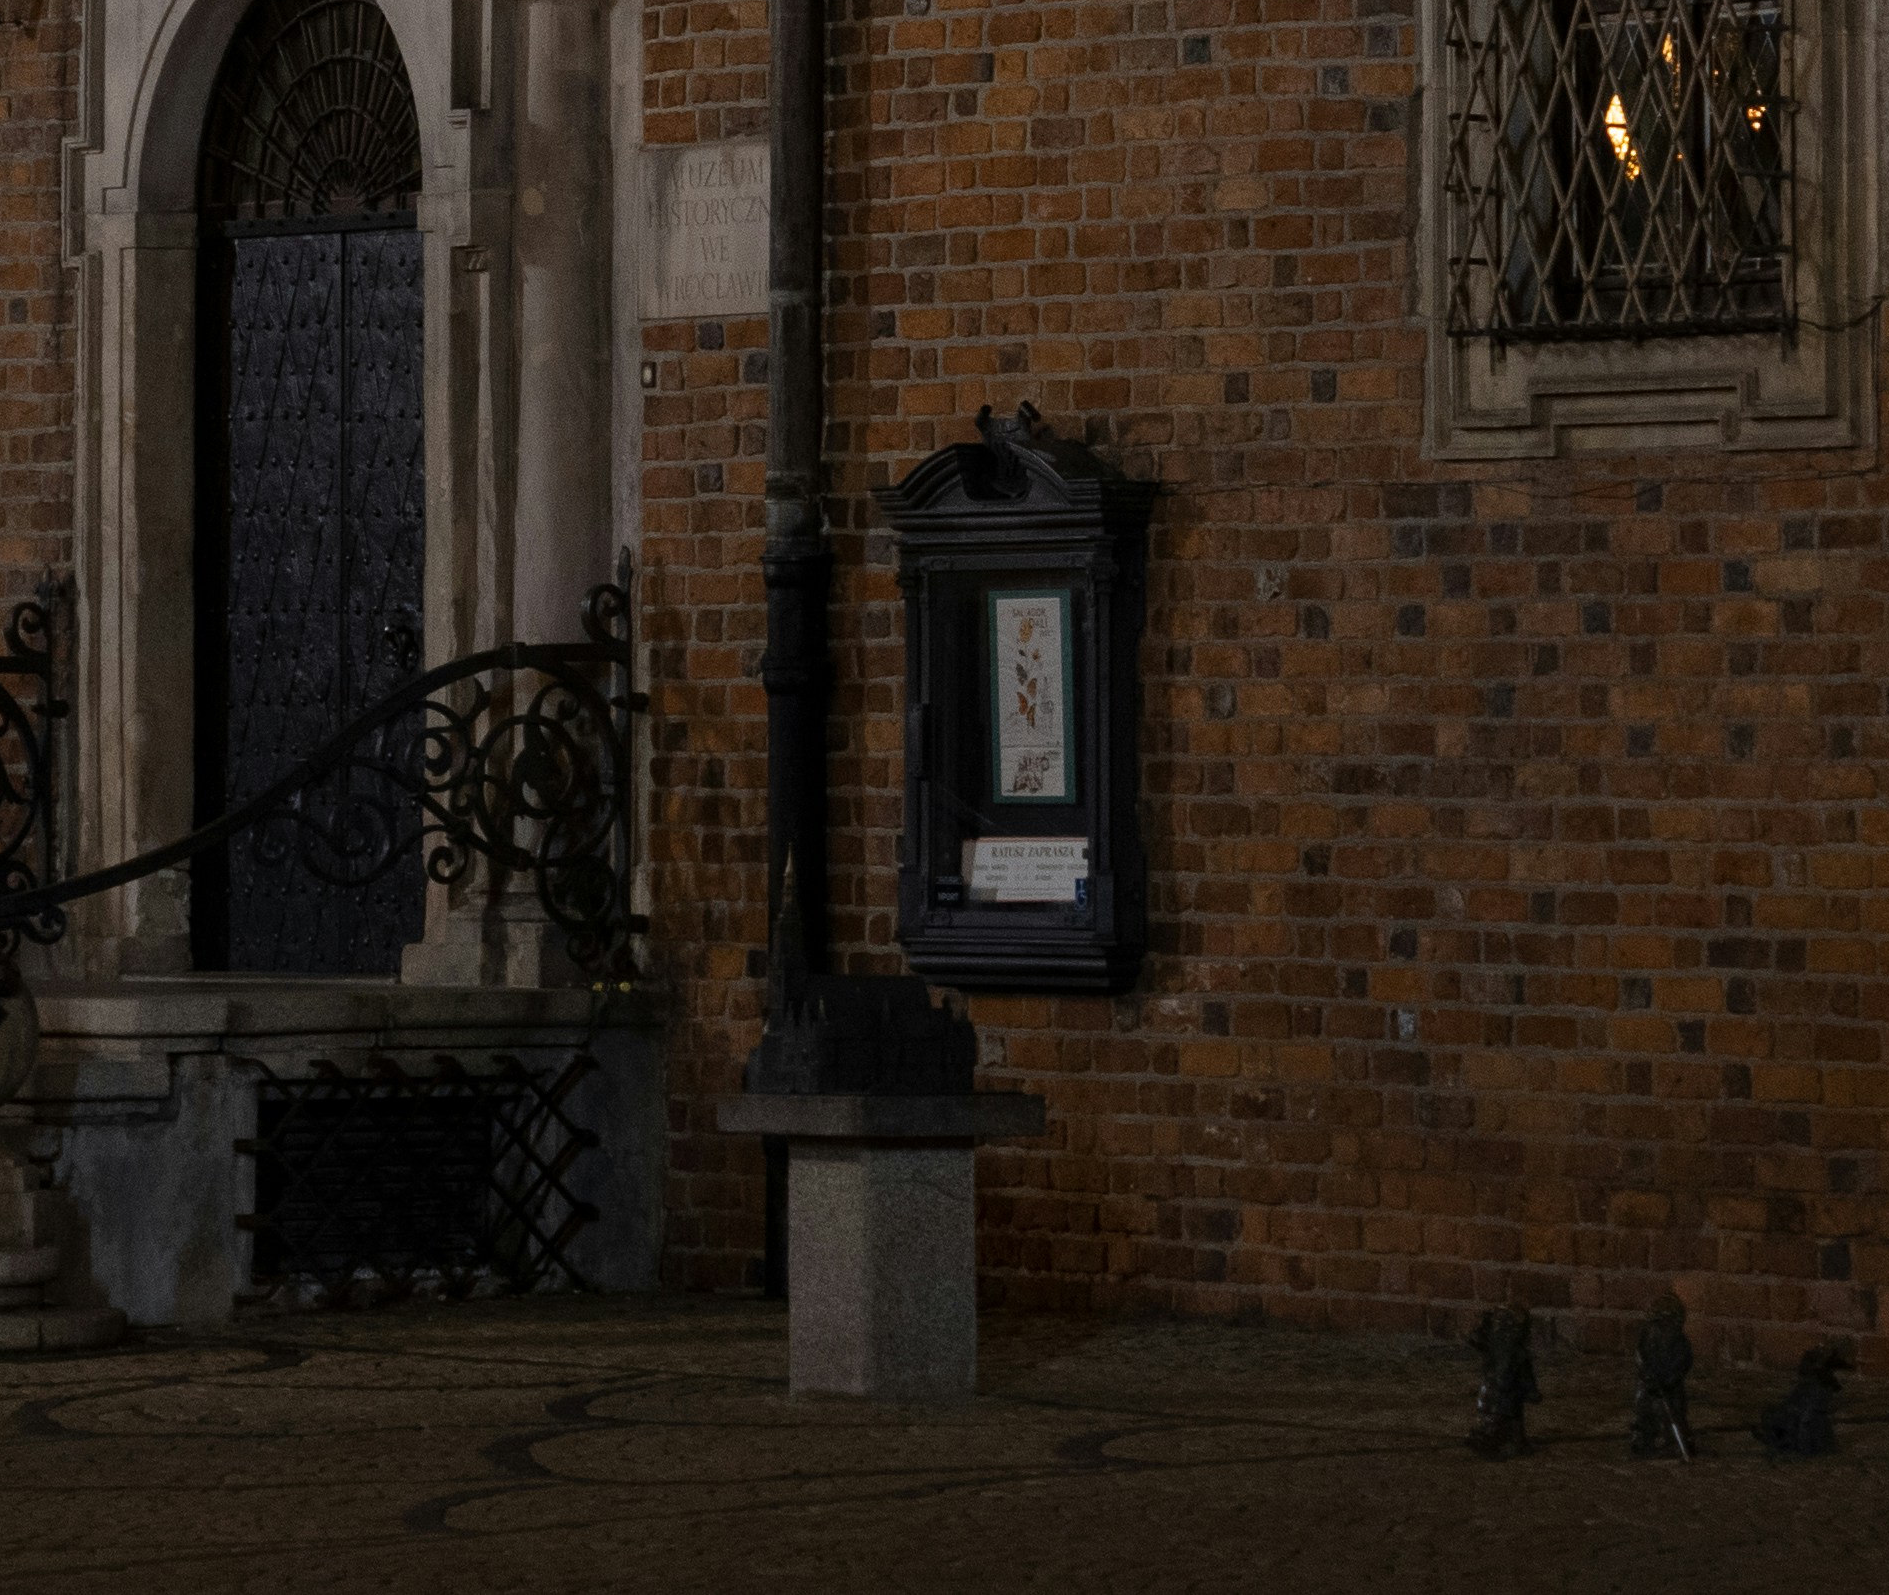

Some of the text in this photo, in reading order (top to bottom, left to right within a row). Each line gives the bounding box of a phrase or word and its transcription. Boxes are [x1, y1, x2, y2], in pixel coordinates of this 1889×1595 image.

[668, 156, 764, 192] MUZEUM
[647, 195, 771, 230] HISTORYCZN
[700, 234, 730, 263] WE
[991, 846, 1025, 858] RATUSZ
